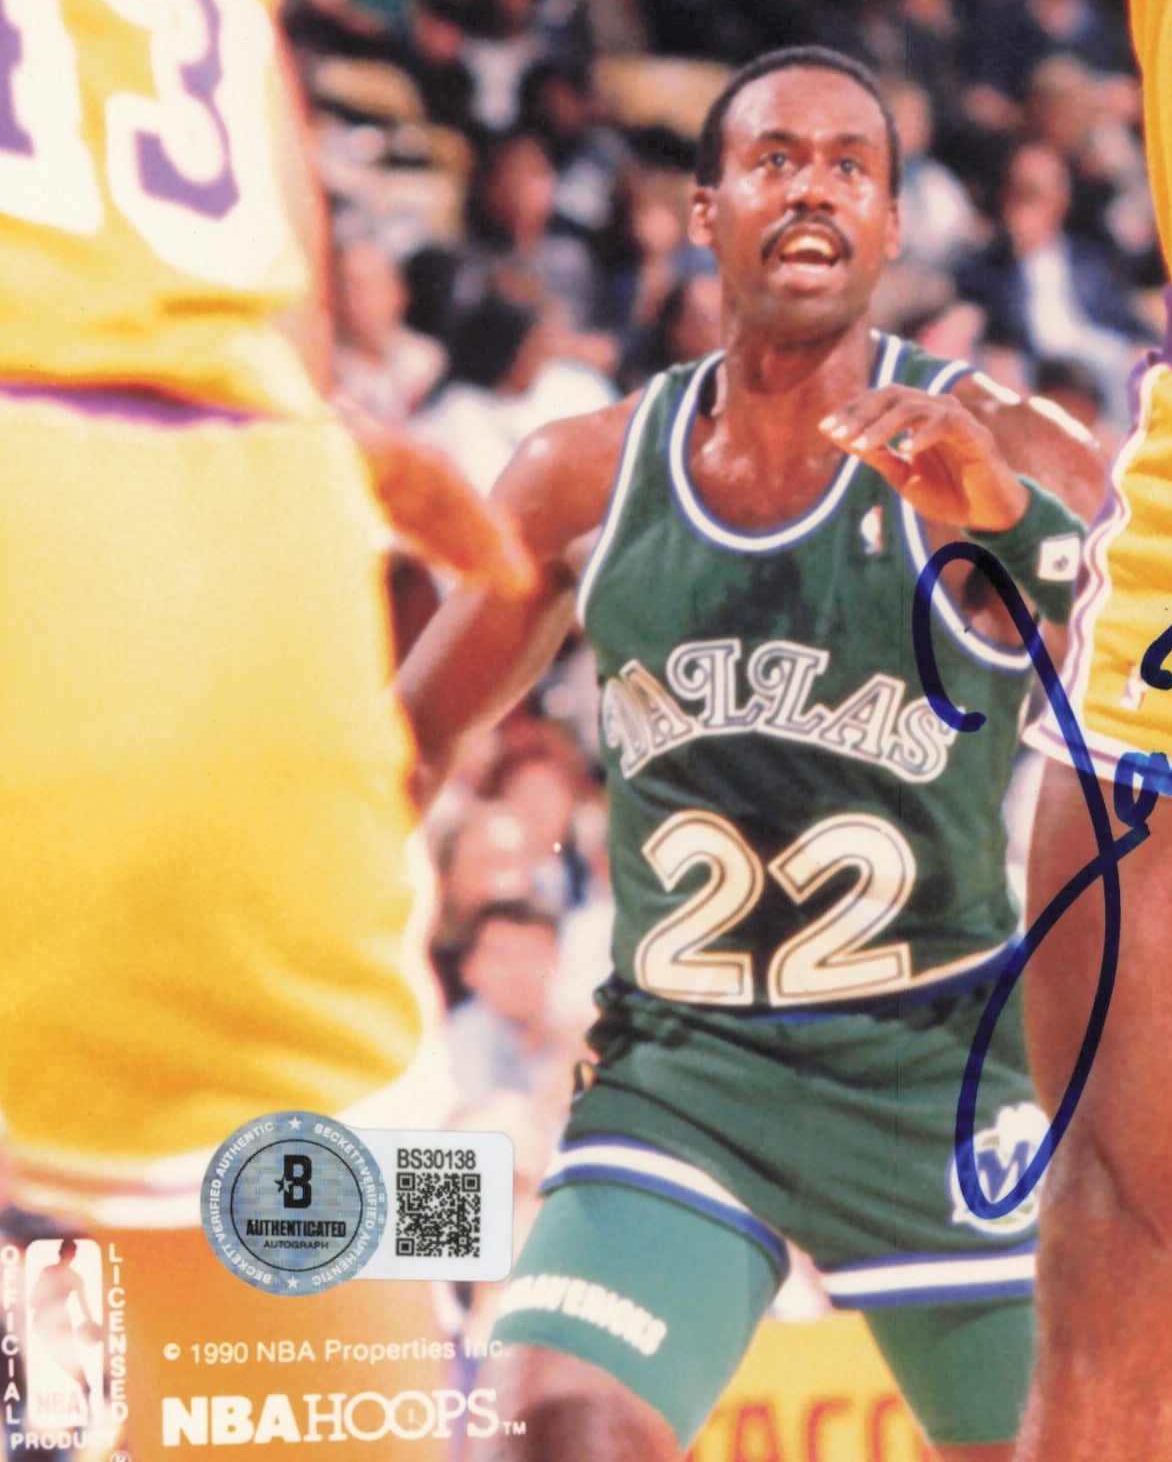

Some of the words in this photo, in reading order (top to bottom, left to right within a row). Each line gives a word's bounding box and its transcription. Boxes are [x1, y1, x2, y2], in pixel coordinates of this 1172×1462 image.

[634, 809, 917, 1008] 22
[215, 1121, 275, 1178] AUTHENTIC
[397, 1148, 477, 1169] BS30138
[208, 1179, 227, 1241] VERIFIED
[360, 1165, 378, 1230] VERIFIED
[246, 1219, 346, 1238] AUTHENTICATED
[263, 1240, 330, 1250] AUTOGRAPH
[312, 1231, 371, 1286] AUTHENTIC
